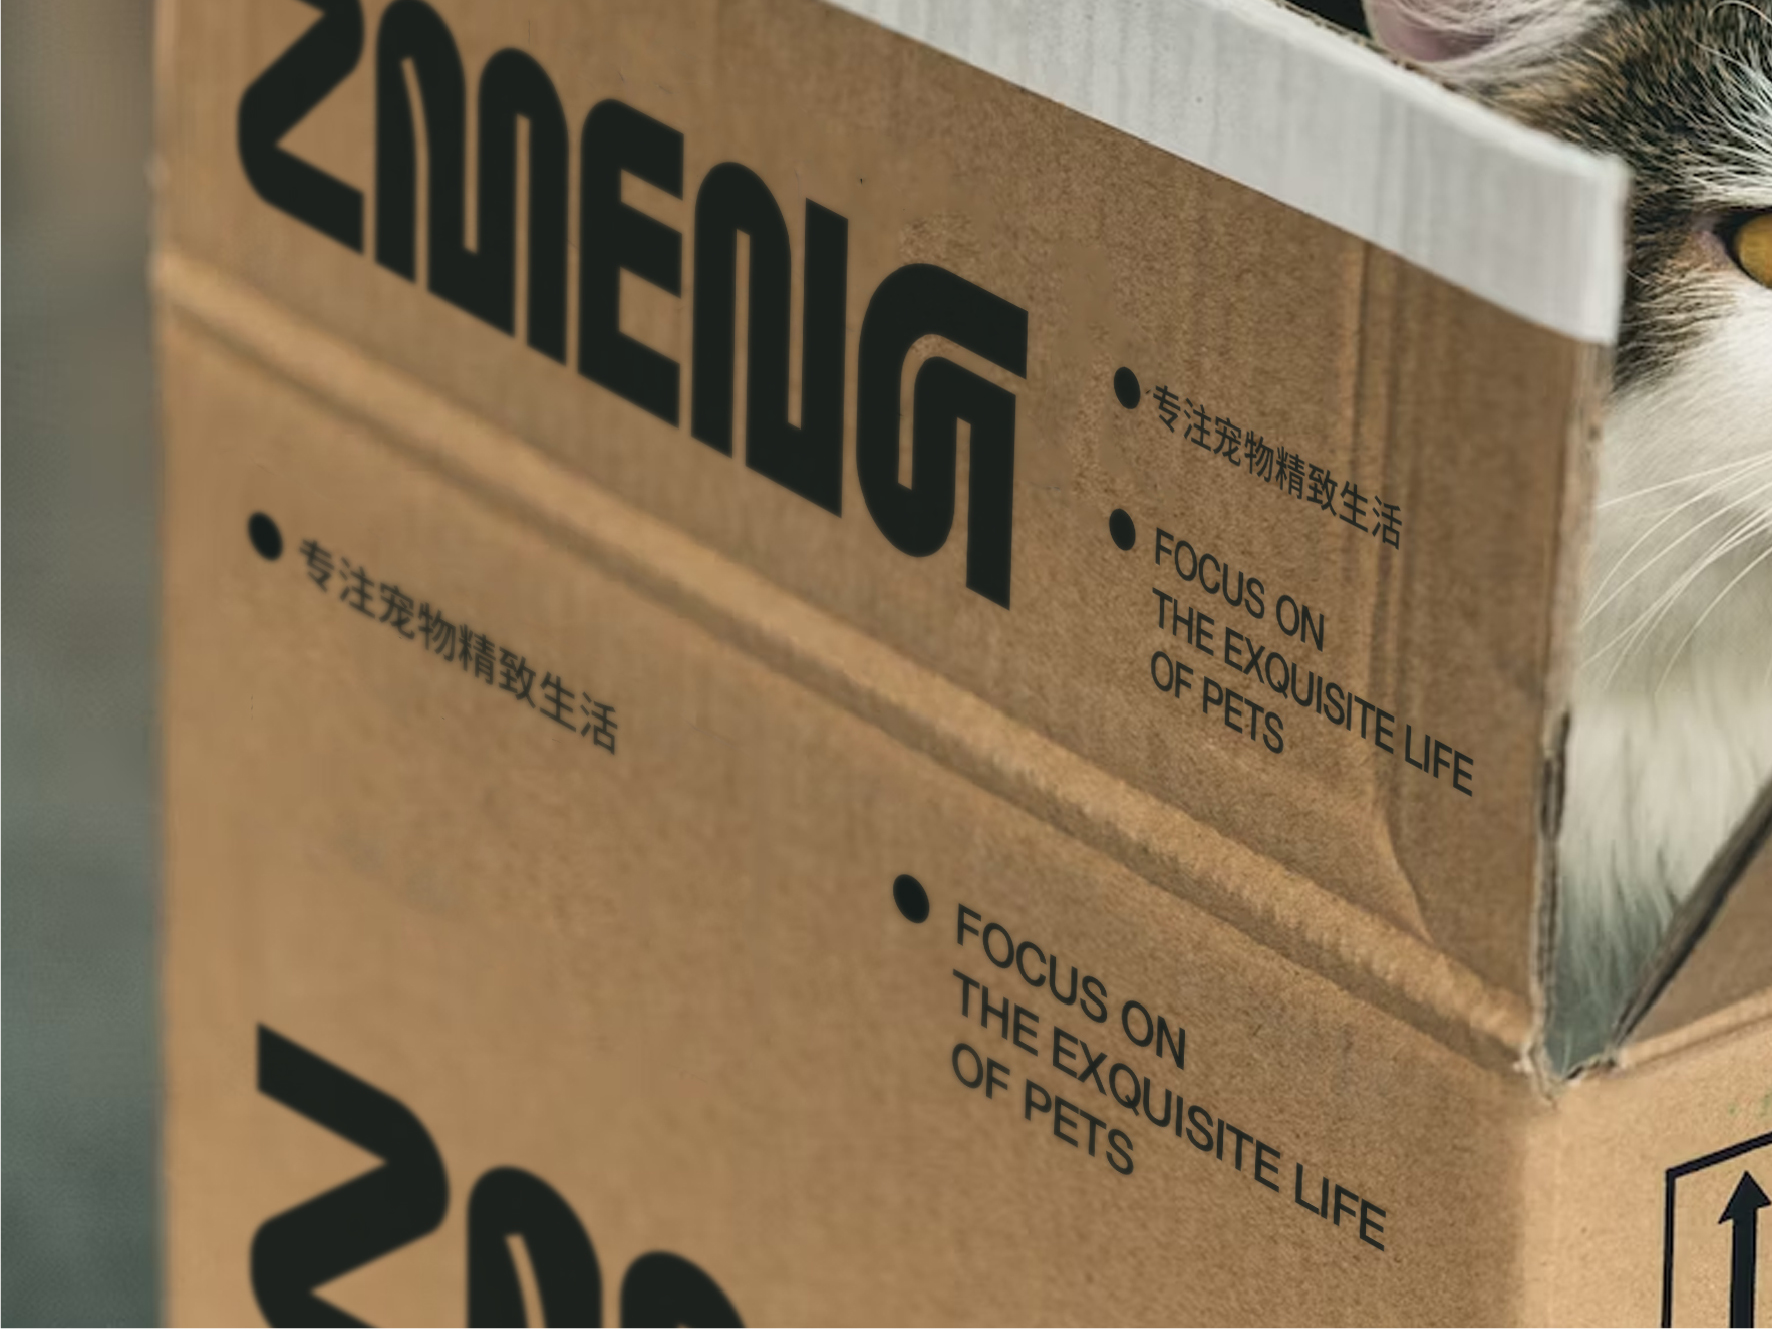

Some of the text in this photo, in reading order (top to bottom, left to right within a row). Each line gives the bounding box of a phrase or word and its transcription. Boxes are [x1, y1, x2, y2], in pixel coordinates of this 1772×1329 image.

[1151, 384, 1404, 551] 专注宠物精致生活
[298, 537, 621, 757] 专注宠物精致生活
[1154, 526, 1326, 652] FOCUS ON
[1149, 650, 1285, 756] OF PETS
[1151, 586, 1475, 798] THE EXQUISITE LIFE
[956, 902, 1187, 1072] FOCUS ON
[950, 1041, 1135, 1177] OF PETS
[951, 968, 1388, 1253] THE EXQUISITE LIFE
